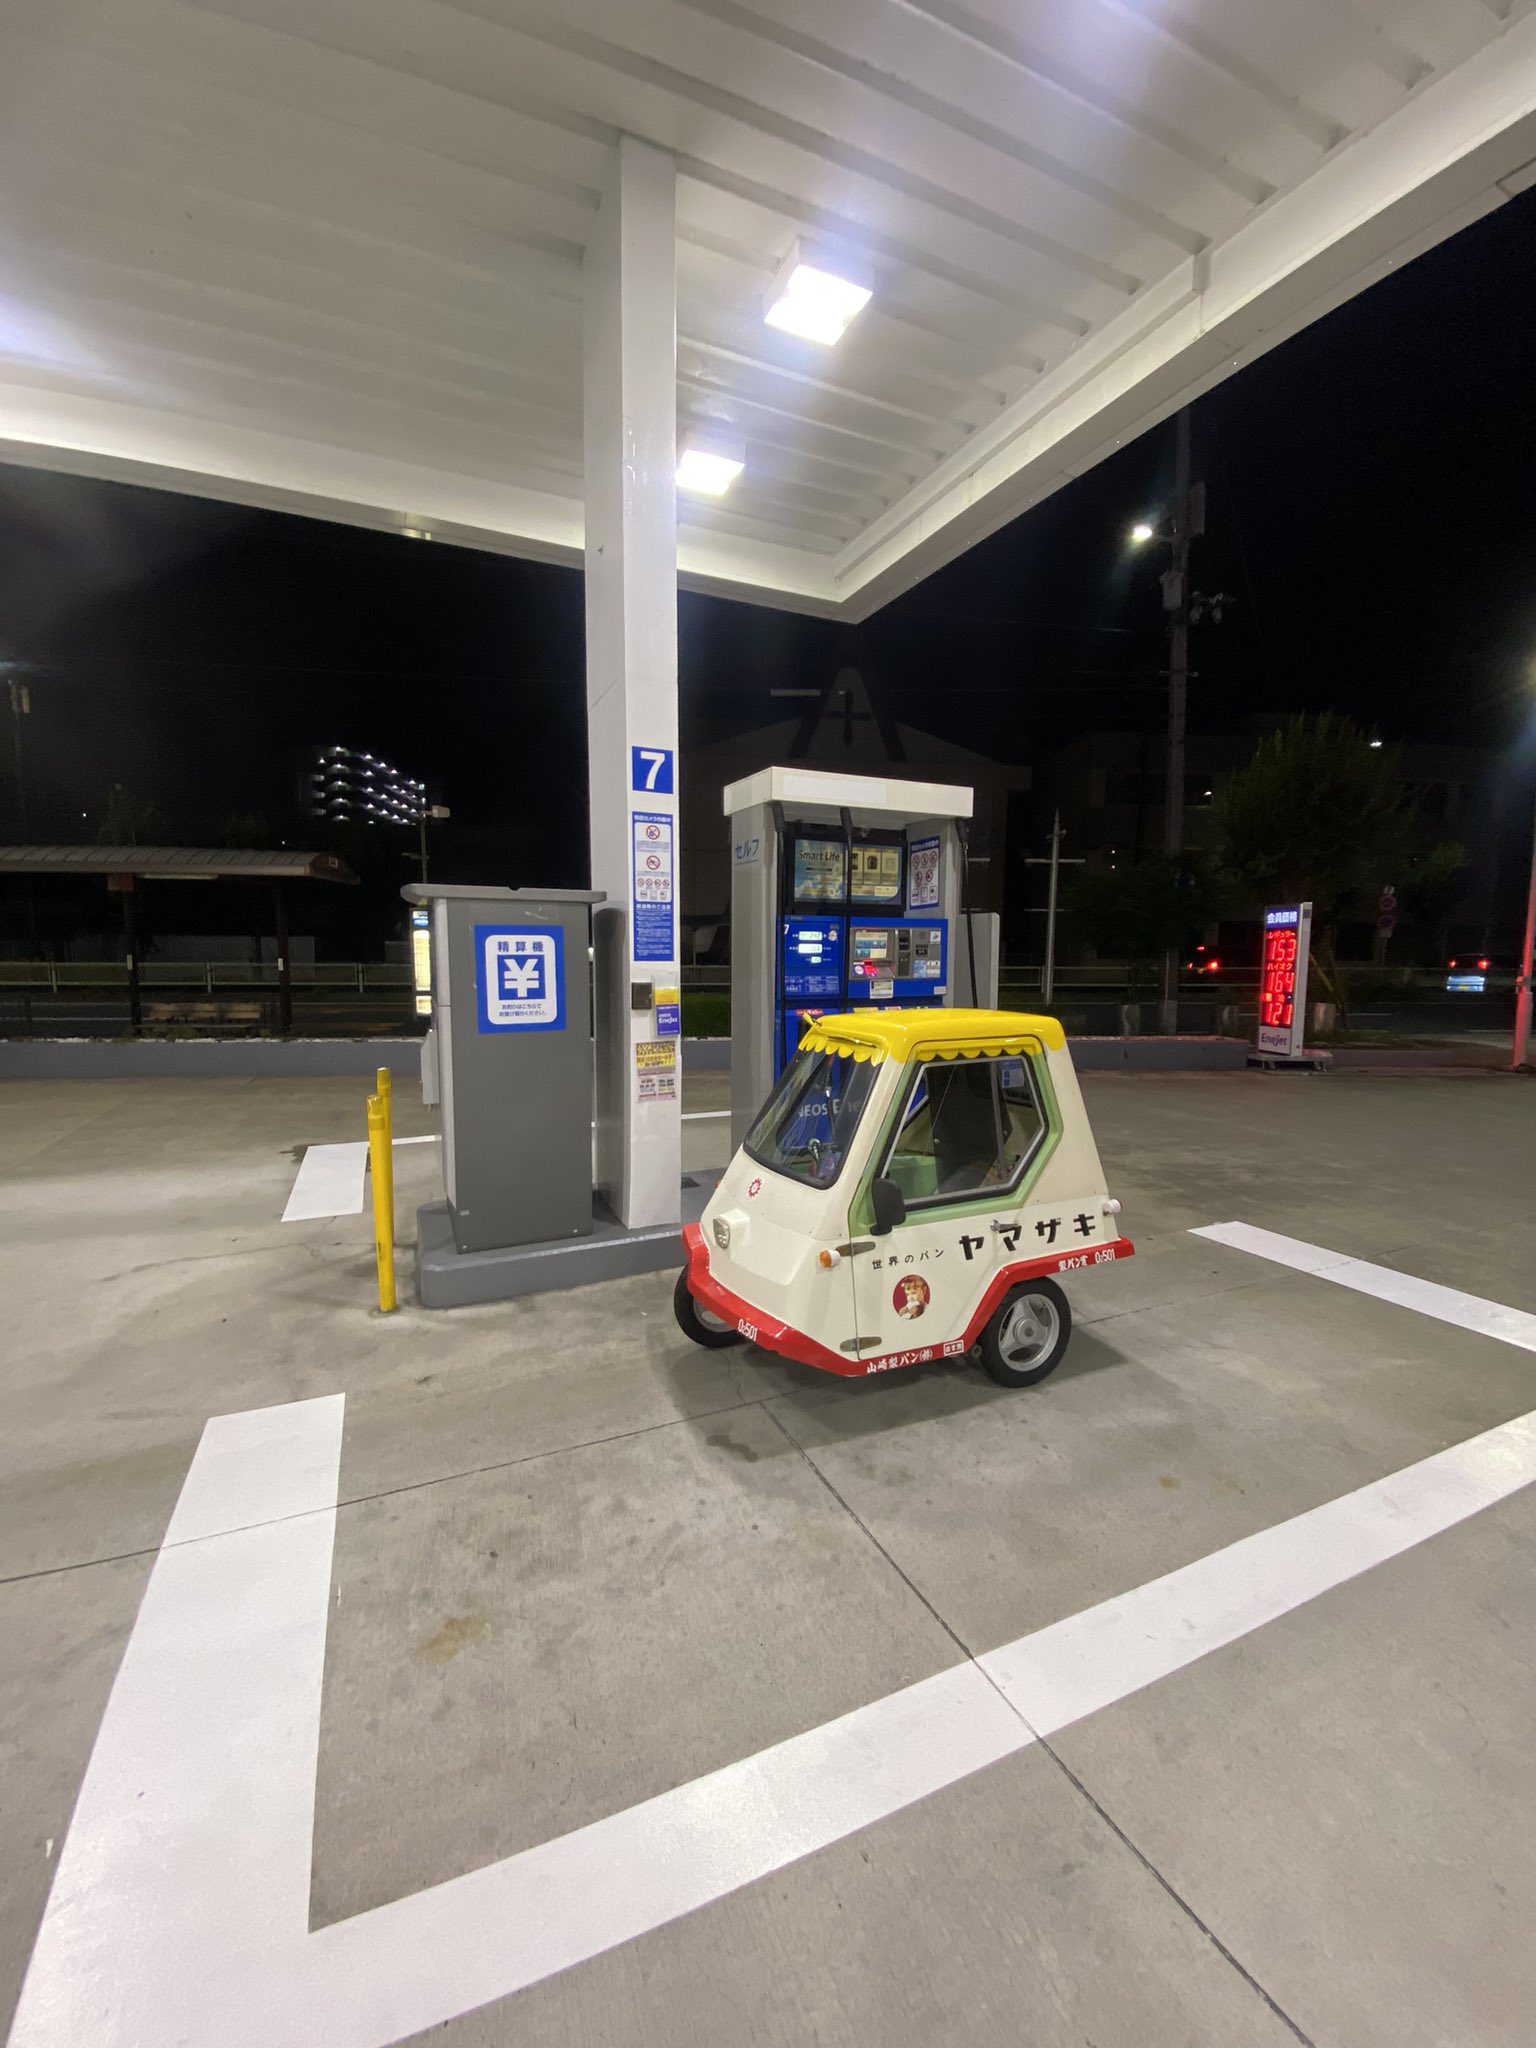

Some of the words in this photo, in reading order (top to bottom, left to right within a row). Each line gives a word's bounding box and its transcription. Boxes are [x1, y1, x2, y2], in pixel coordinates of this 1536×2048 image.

[640, 750, 666, 790] 7
[735, 839, 760, 860] セルフ
[799, 850, 823, 861] Smart
[825, 851, 841, 862] Life
[1267, 911, 1298, 924] 会員価格
[1268, 931, 1296, 939] レギュラー
[497, 941, 544, 953] 精算機
[1270, 939, 1297, 961] 153
[1267, 962, 1293, 971] ハイオク
[1268, 971, 1295, 992] 164
[1266, 1003, 1293, 1025] 121
[872, 1249, 944, 1270] 世界のパン
[959, 1214, 1096, 1260] ヤマザキ
